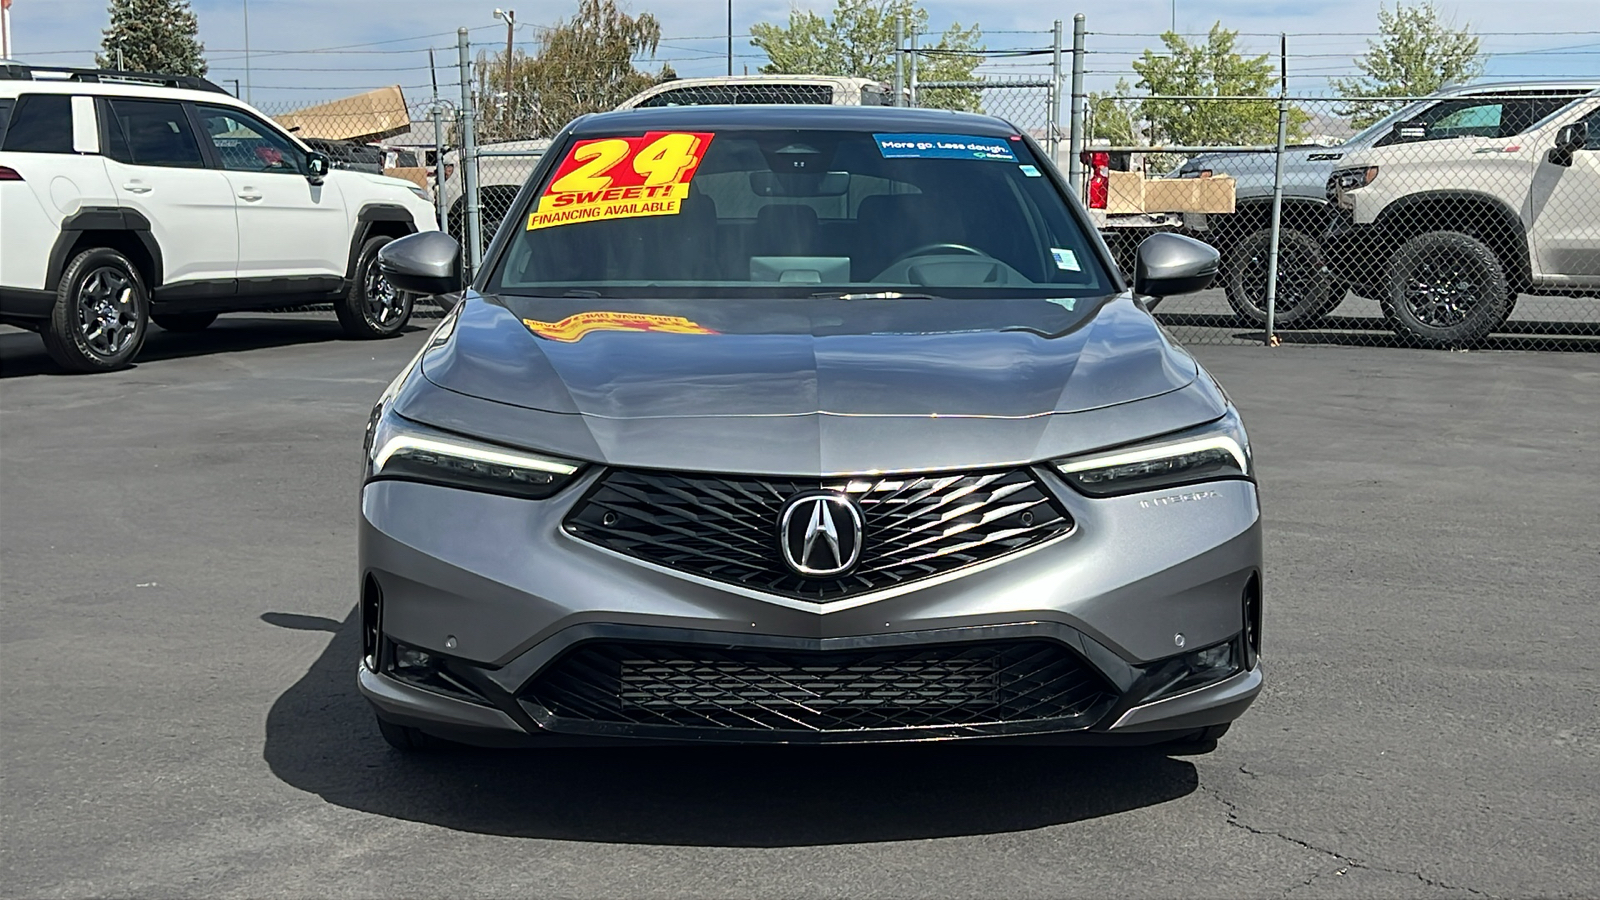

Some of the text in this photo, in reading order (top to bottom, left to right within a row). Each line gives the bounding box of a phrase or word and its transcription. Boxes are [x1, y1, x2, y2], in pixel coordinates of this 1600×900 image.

[881, 141, 1009, 154] More go. Less dough.
[551, 133, 701, 193] 24
[552, 185, 672, 208] SWEET!
[531, 201, 676, 226] FINANCING AVAILABLE
